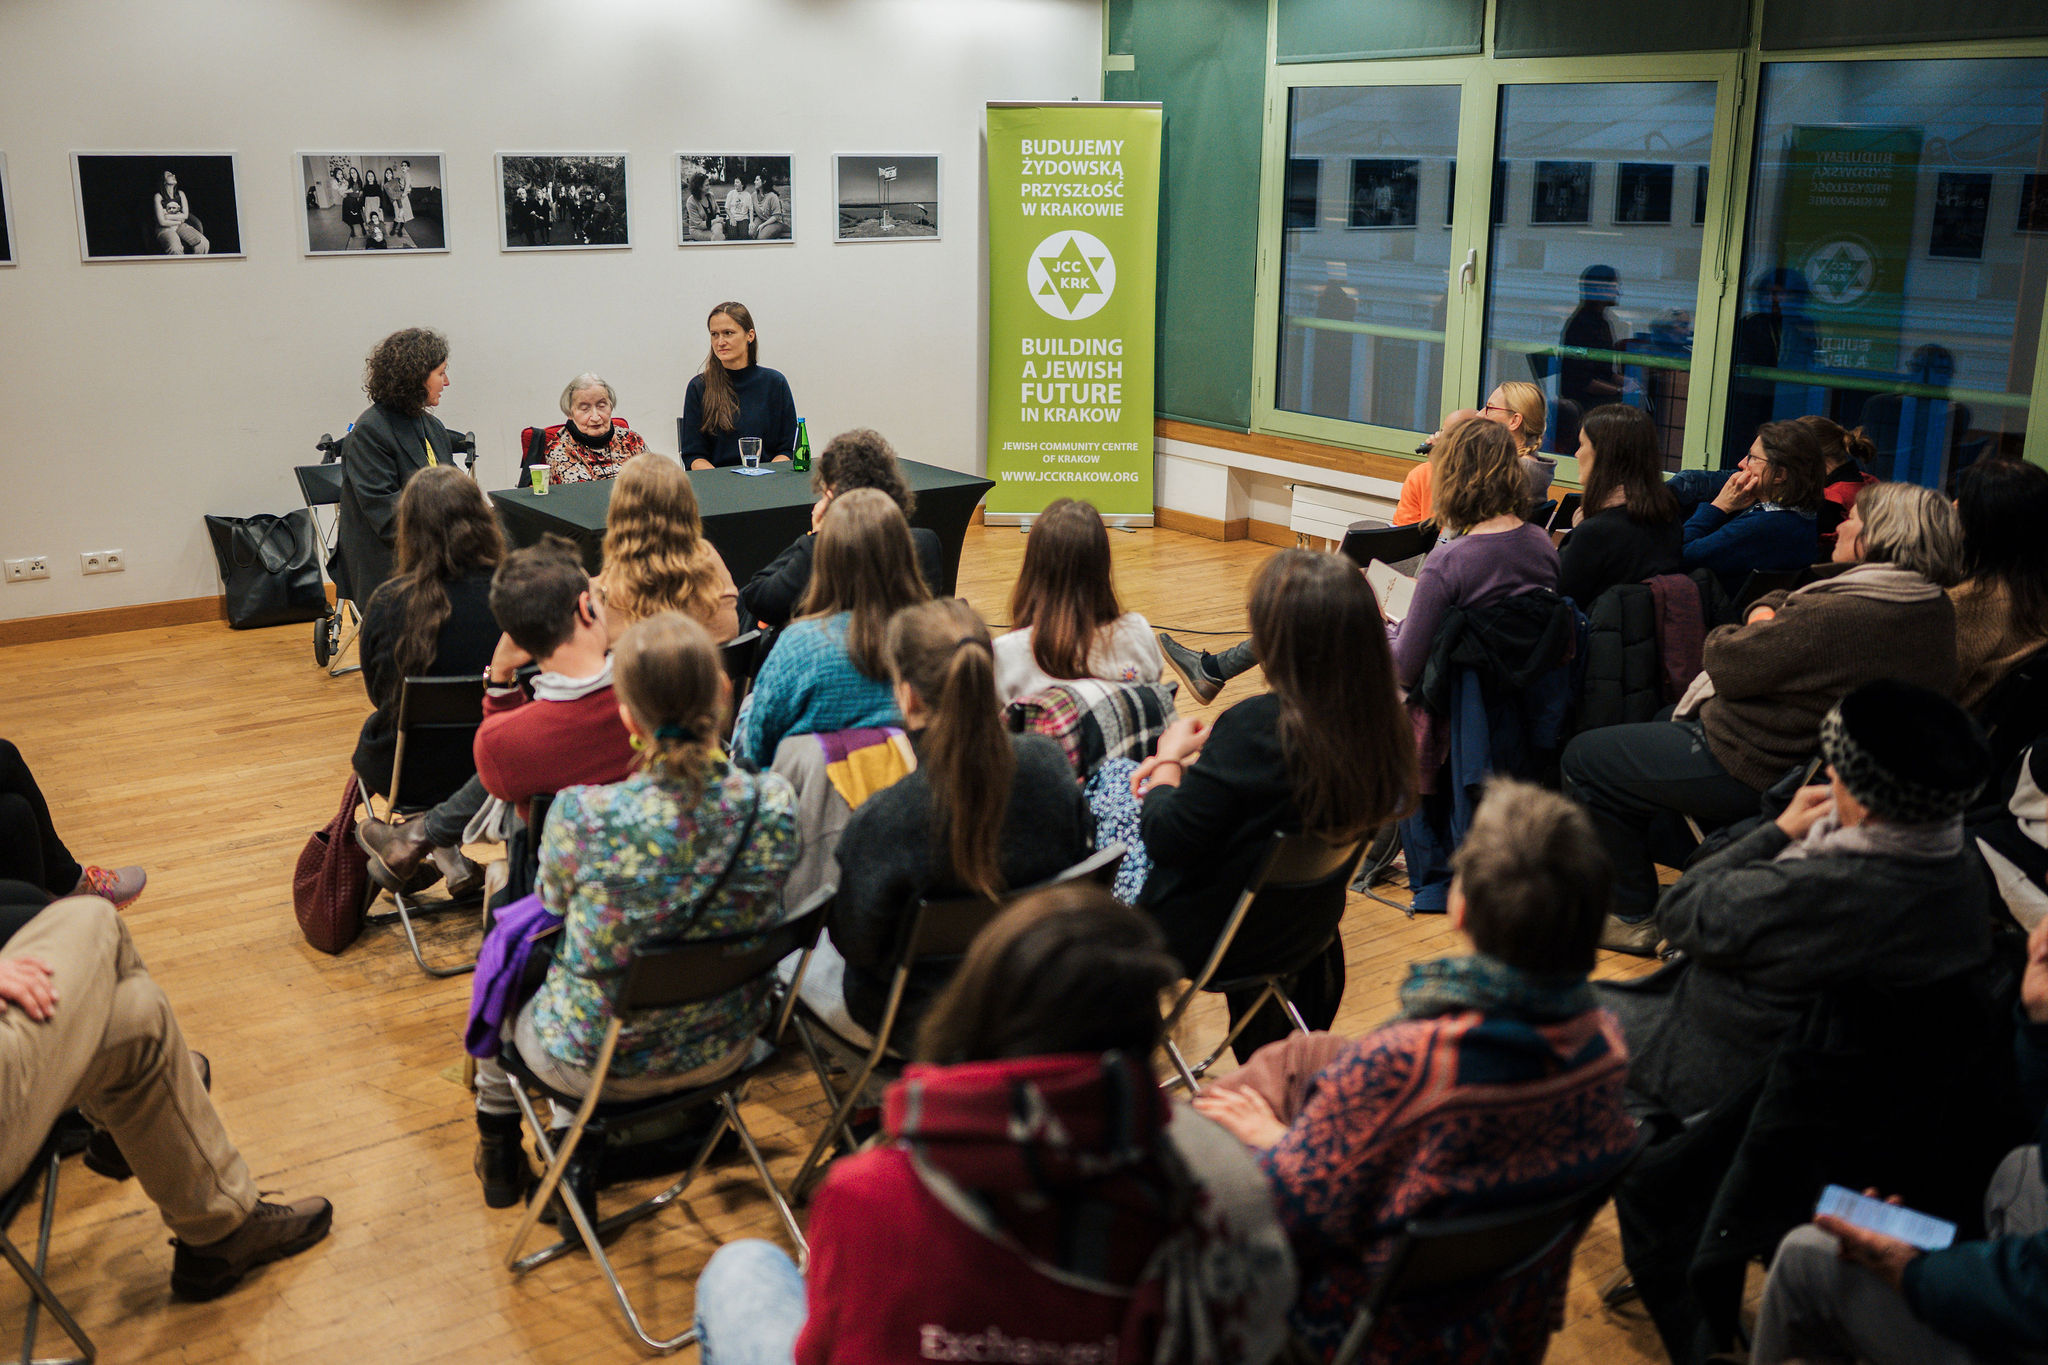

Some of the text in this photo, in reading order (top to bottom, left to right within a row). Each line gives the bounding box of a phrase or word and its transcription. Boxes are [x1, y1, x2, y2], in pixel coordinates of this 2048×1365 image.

[1021, 139, 1125, 156] BUDUJEMY
[1021, 157, 1125, 180] ŻYDOWSKĄ
[1021, 181, 1125, 198] PRZYSZŁOŚĆ
[1021, 203, 1125, 217] W KRAKOWIE
[1052, 261, 1082, 273] JCC
[1060, 277, 1090, 289] KRK
[1021, 338, 1124, 356] BUILDING
[1021, 361, 1123, 379] A JEWISH
[1021, 383, 1122, 404] FUTURE
[1021, 408, 1122, 423] IN KRAKOW
[1002, 442, 1139, 452] JEWISH COMMUNITY CENTRE
[1042, 455, 1101, 464] OF KRAKOW
[1001, 472, 1139, 482] WWW.JCCKRAKOW.ORG
